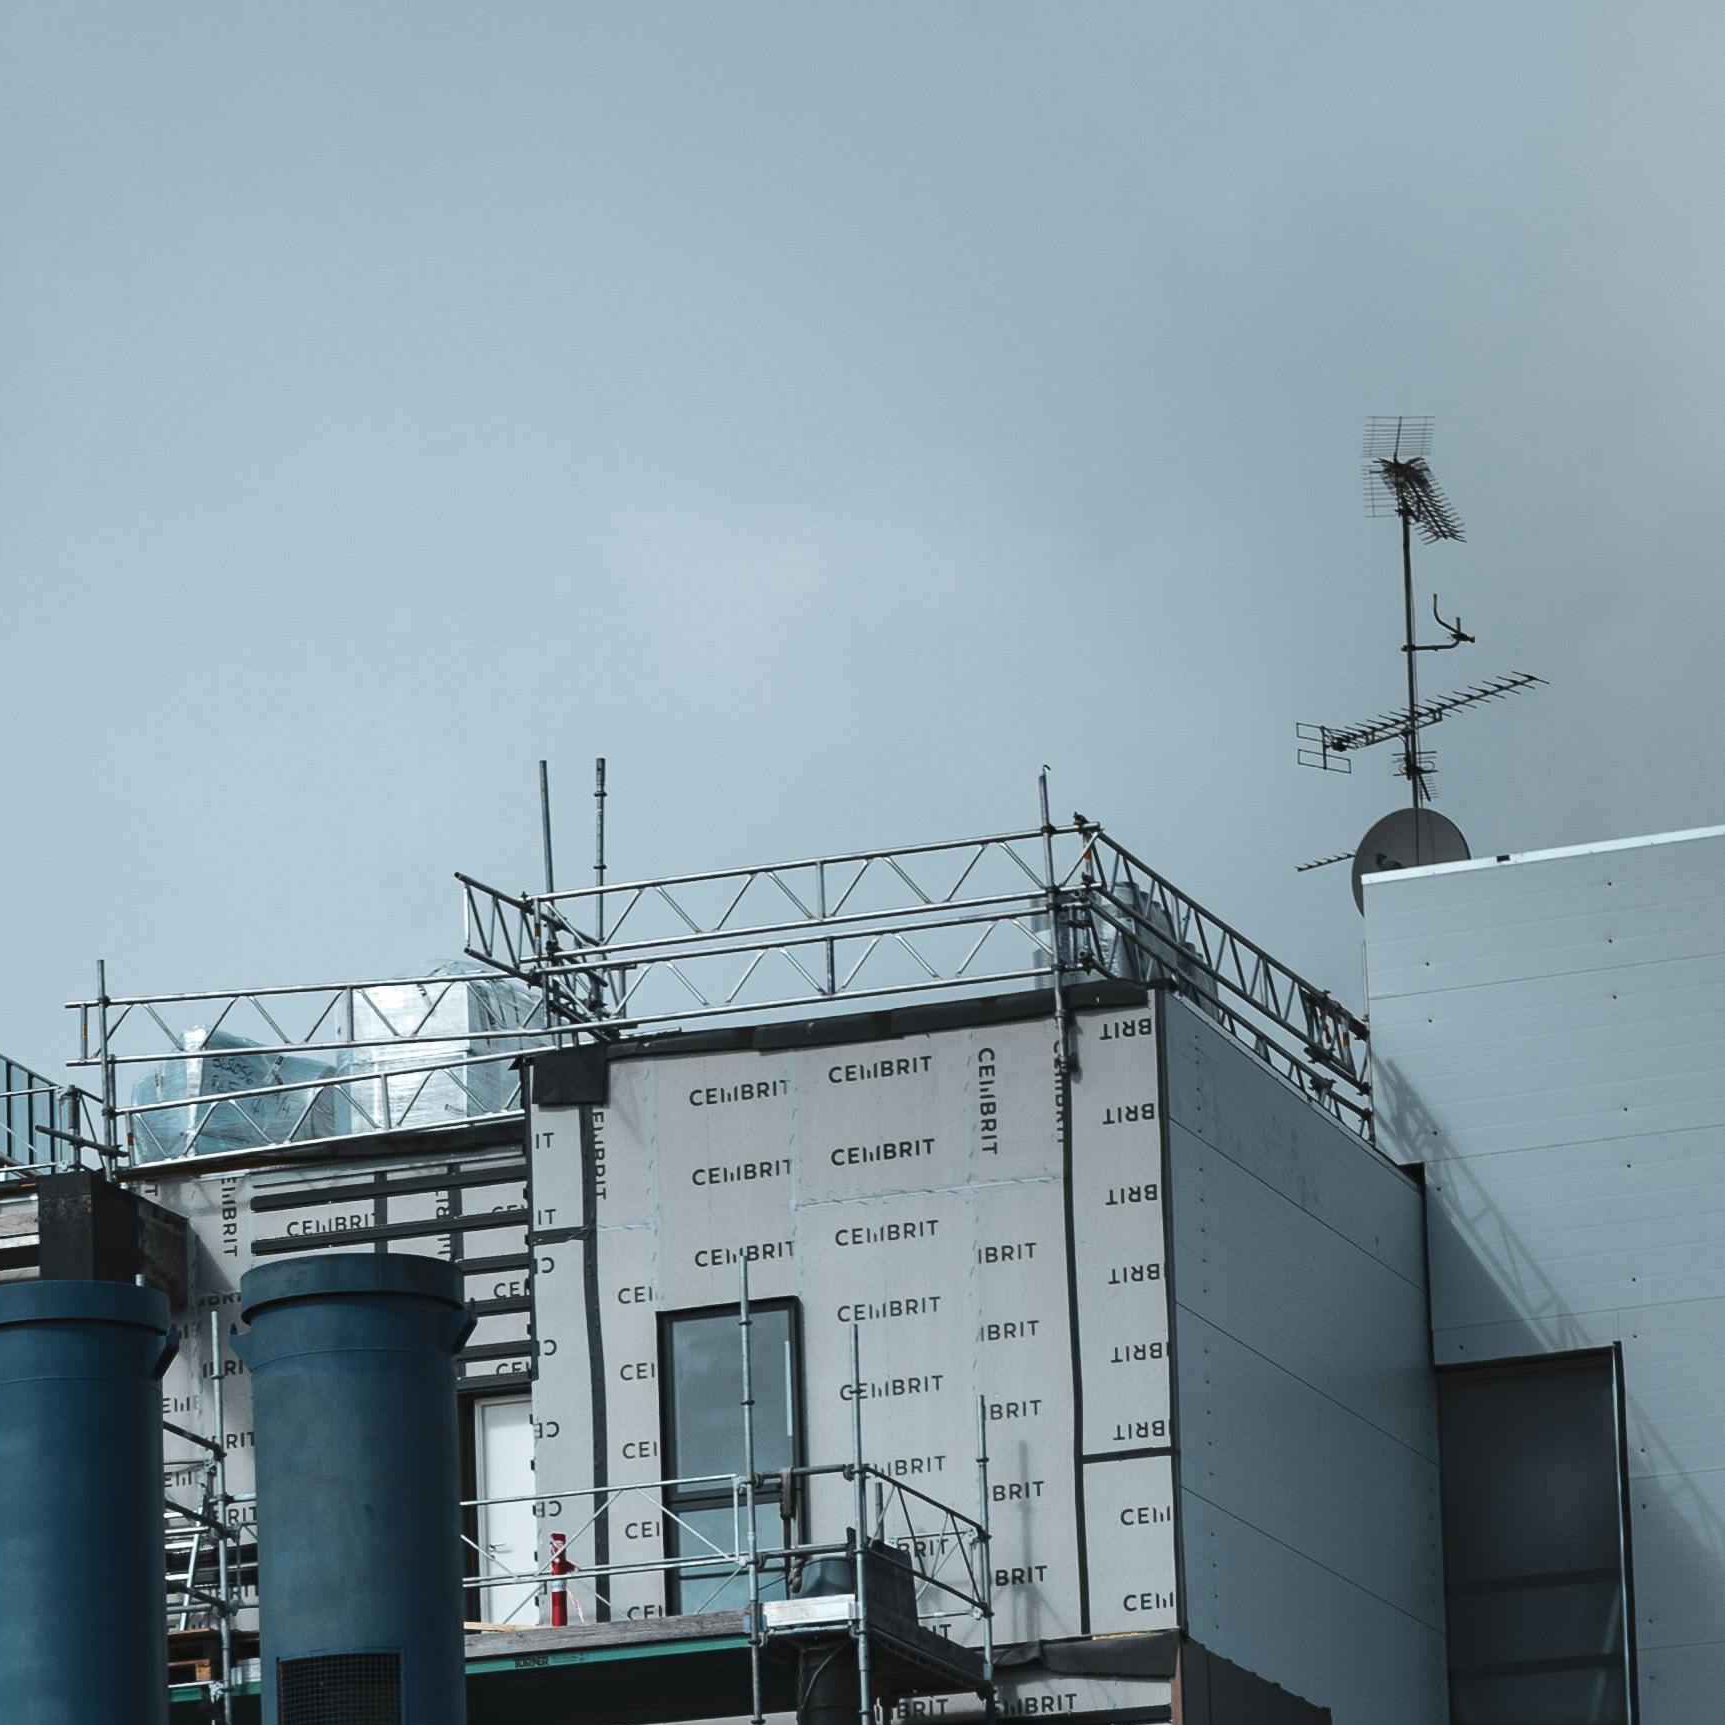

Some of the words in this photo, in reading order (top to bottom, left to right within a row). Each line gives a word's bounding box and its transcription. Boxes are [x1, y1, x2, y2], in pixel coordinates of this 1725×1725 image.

[828, 1056, 933, 1084] CEMBRIT
[689, 1079, 789, 1107] CEMBRIT
[978, 1048, 998, 1155] CEMBRIT
[831, 1138, 936, 1167] CEMBRIT
[691, 1159, 793, 1186] CEMBRIT
[835, 1219, 939, 1247] CEMBRIT
[694, 1240, 796, 1267] CEMBRIT
[837, 1296, 942, 1323] CEMBRIT
